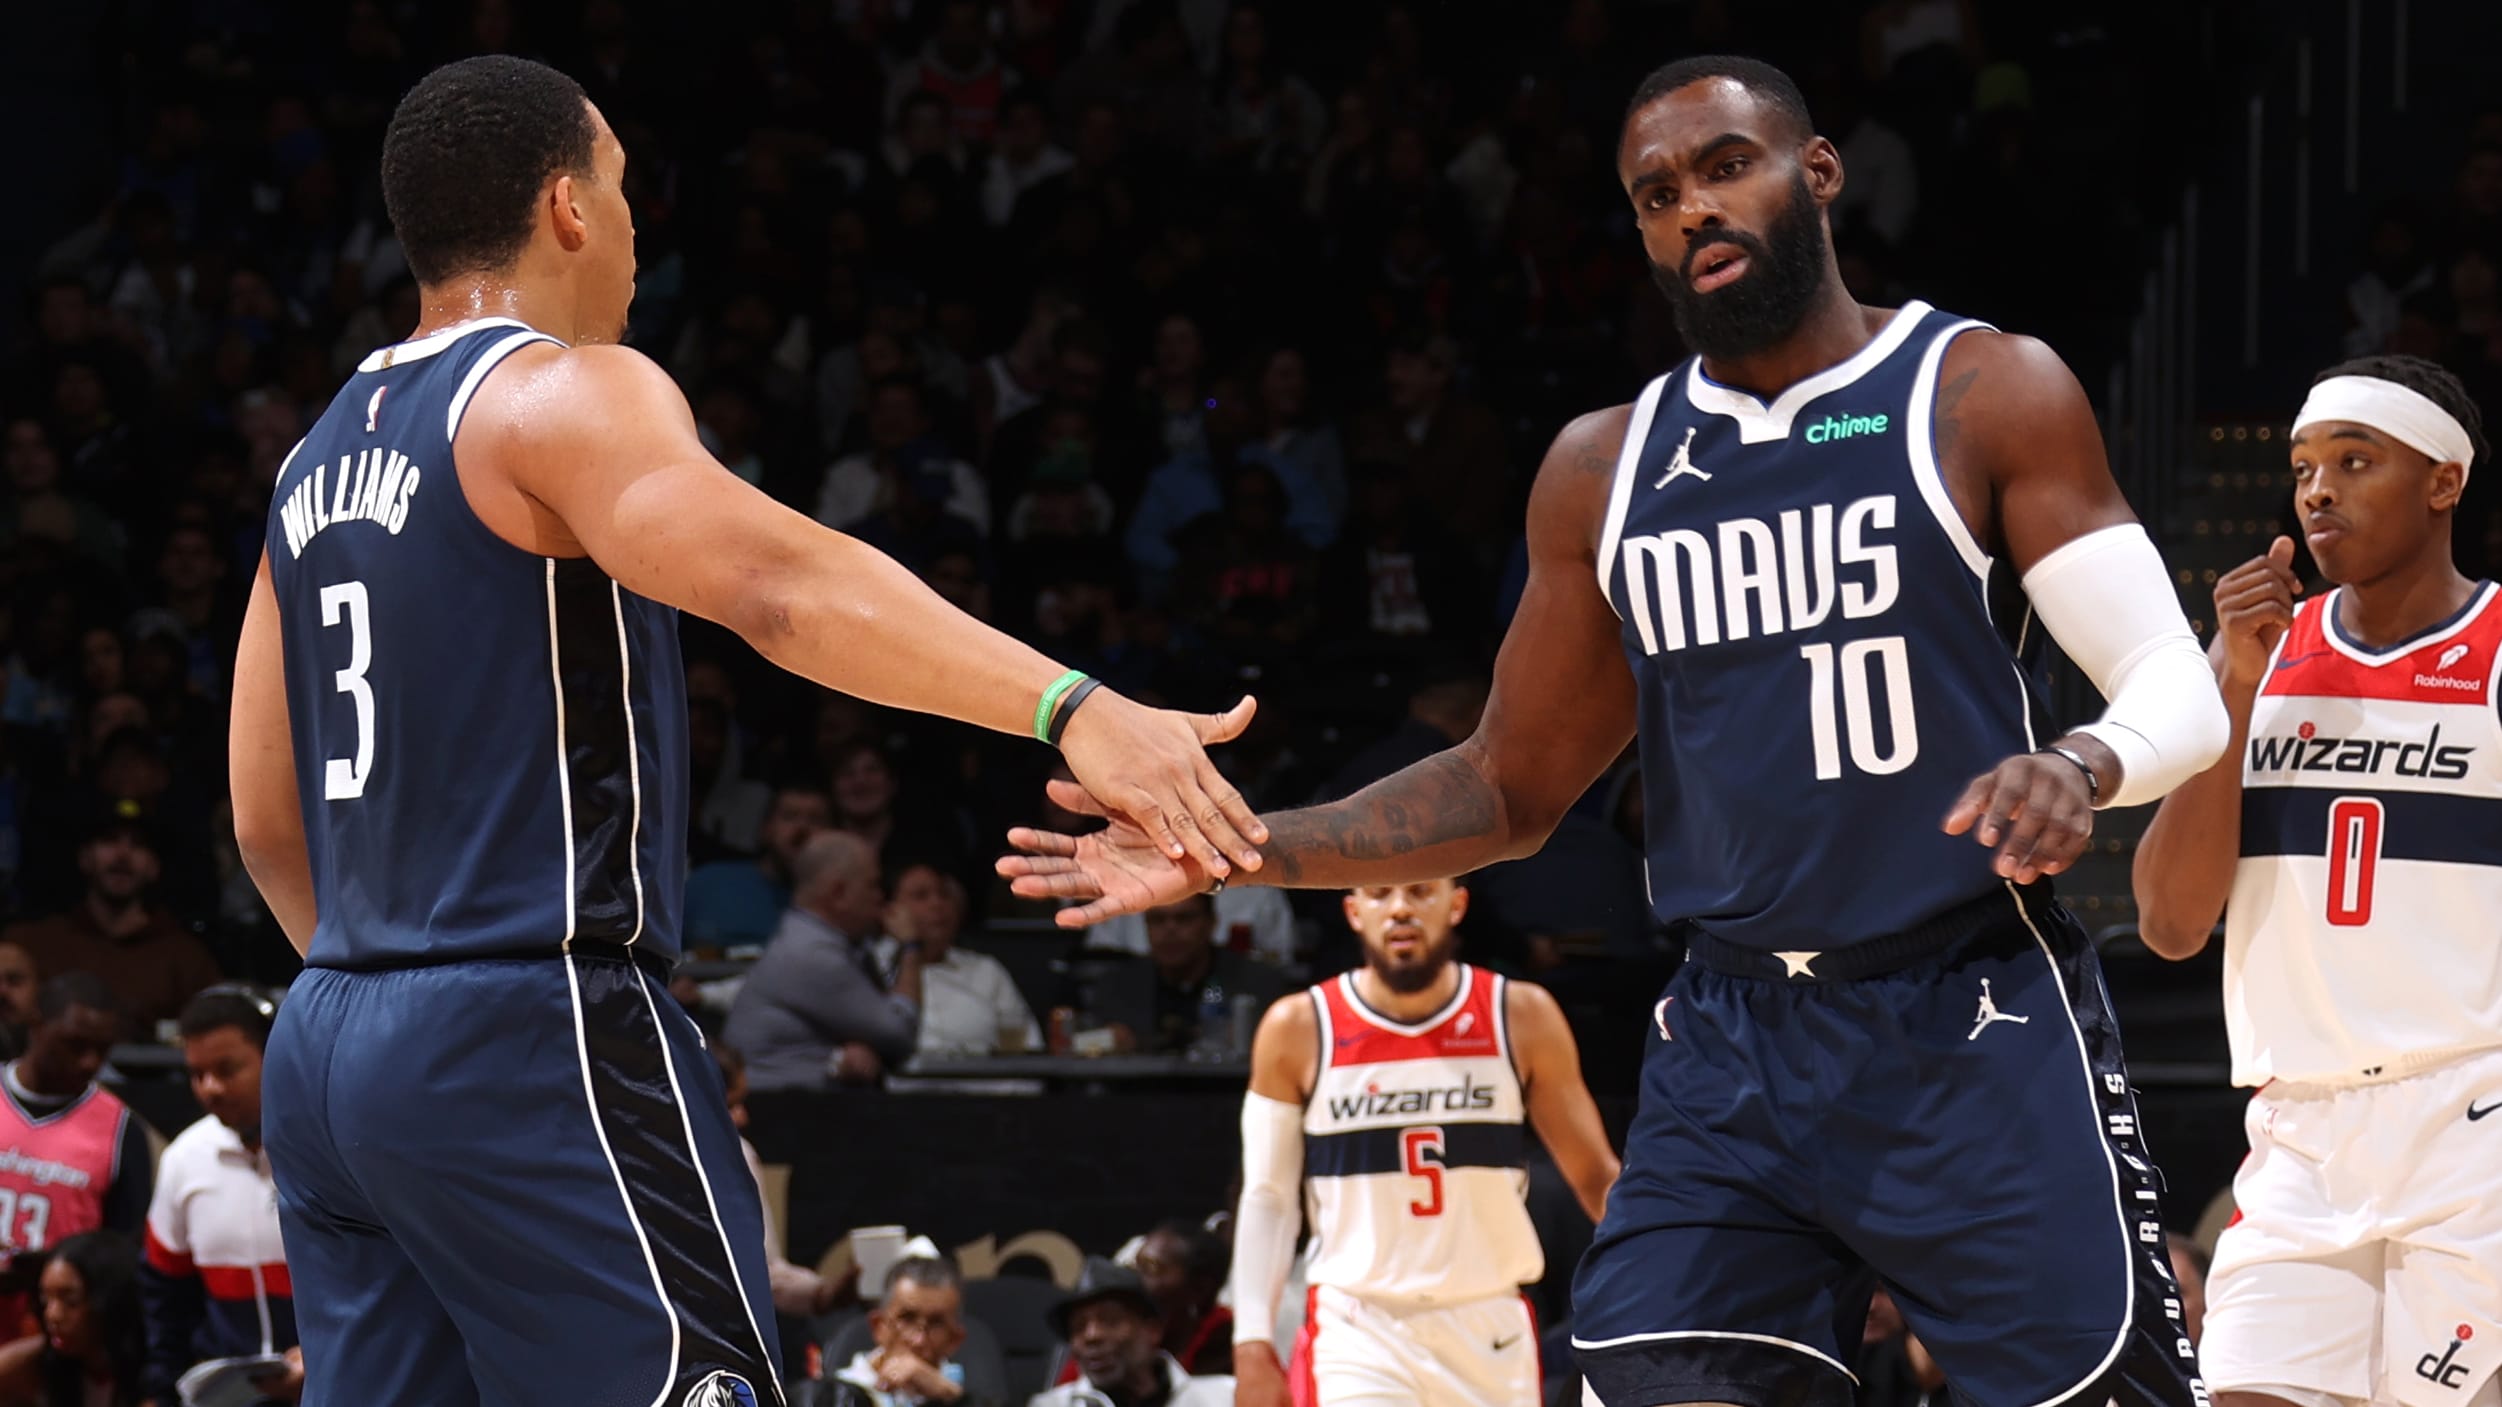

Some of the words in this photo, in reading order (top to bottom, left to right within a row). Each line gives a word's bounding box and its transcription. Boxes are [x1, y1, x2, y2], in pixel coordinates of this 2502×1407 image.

[1805, 412, 1889, 445] chime
[279, 447, 420, 559] WILLIAMS
[1622, 494, 1900, 657] MAVS
[320, 579, 376, 801] 3
[1800, 636, 1919, 781] 10
[2414, 674, 2481, 692] Robinhood
[2250, 721, 2477, 780] wizards
[2325, 796, 2385, 927] 0
[1329, 1071, 1496, 1121] wizards
[1400, 1126, 1446, 1218] 5
